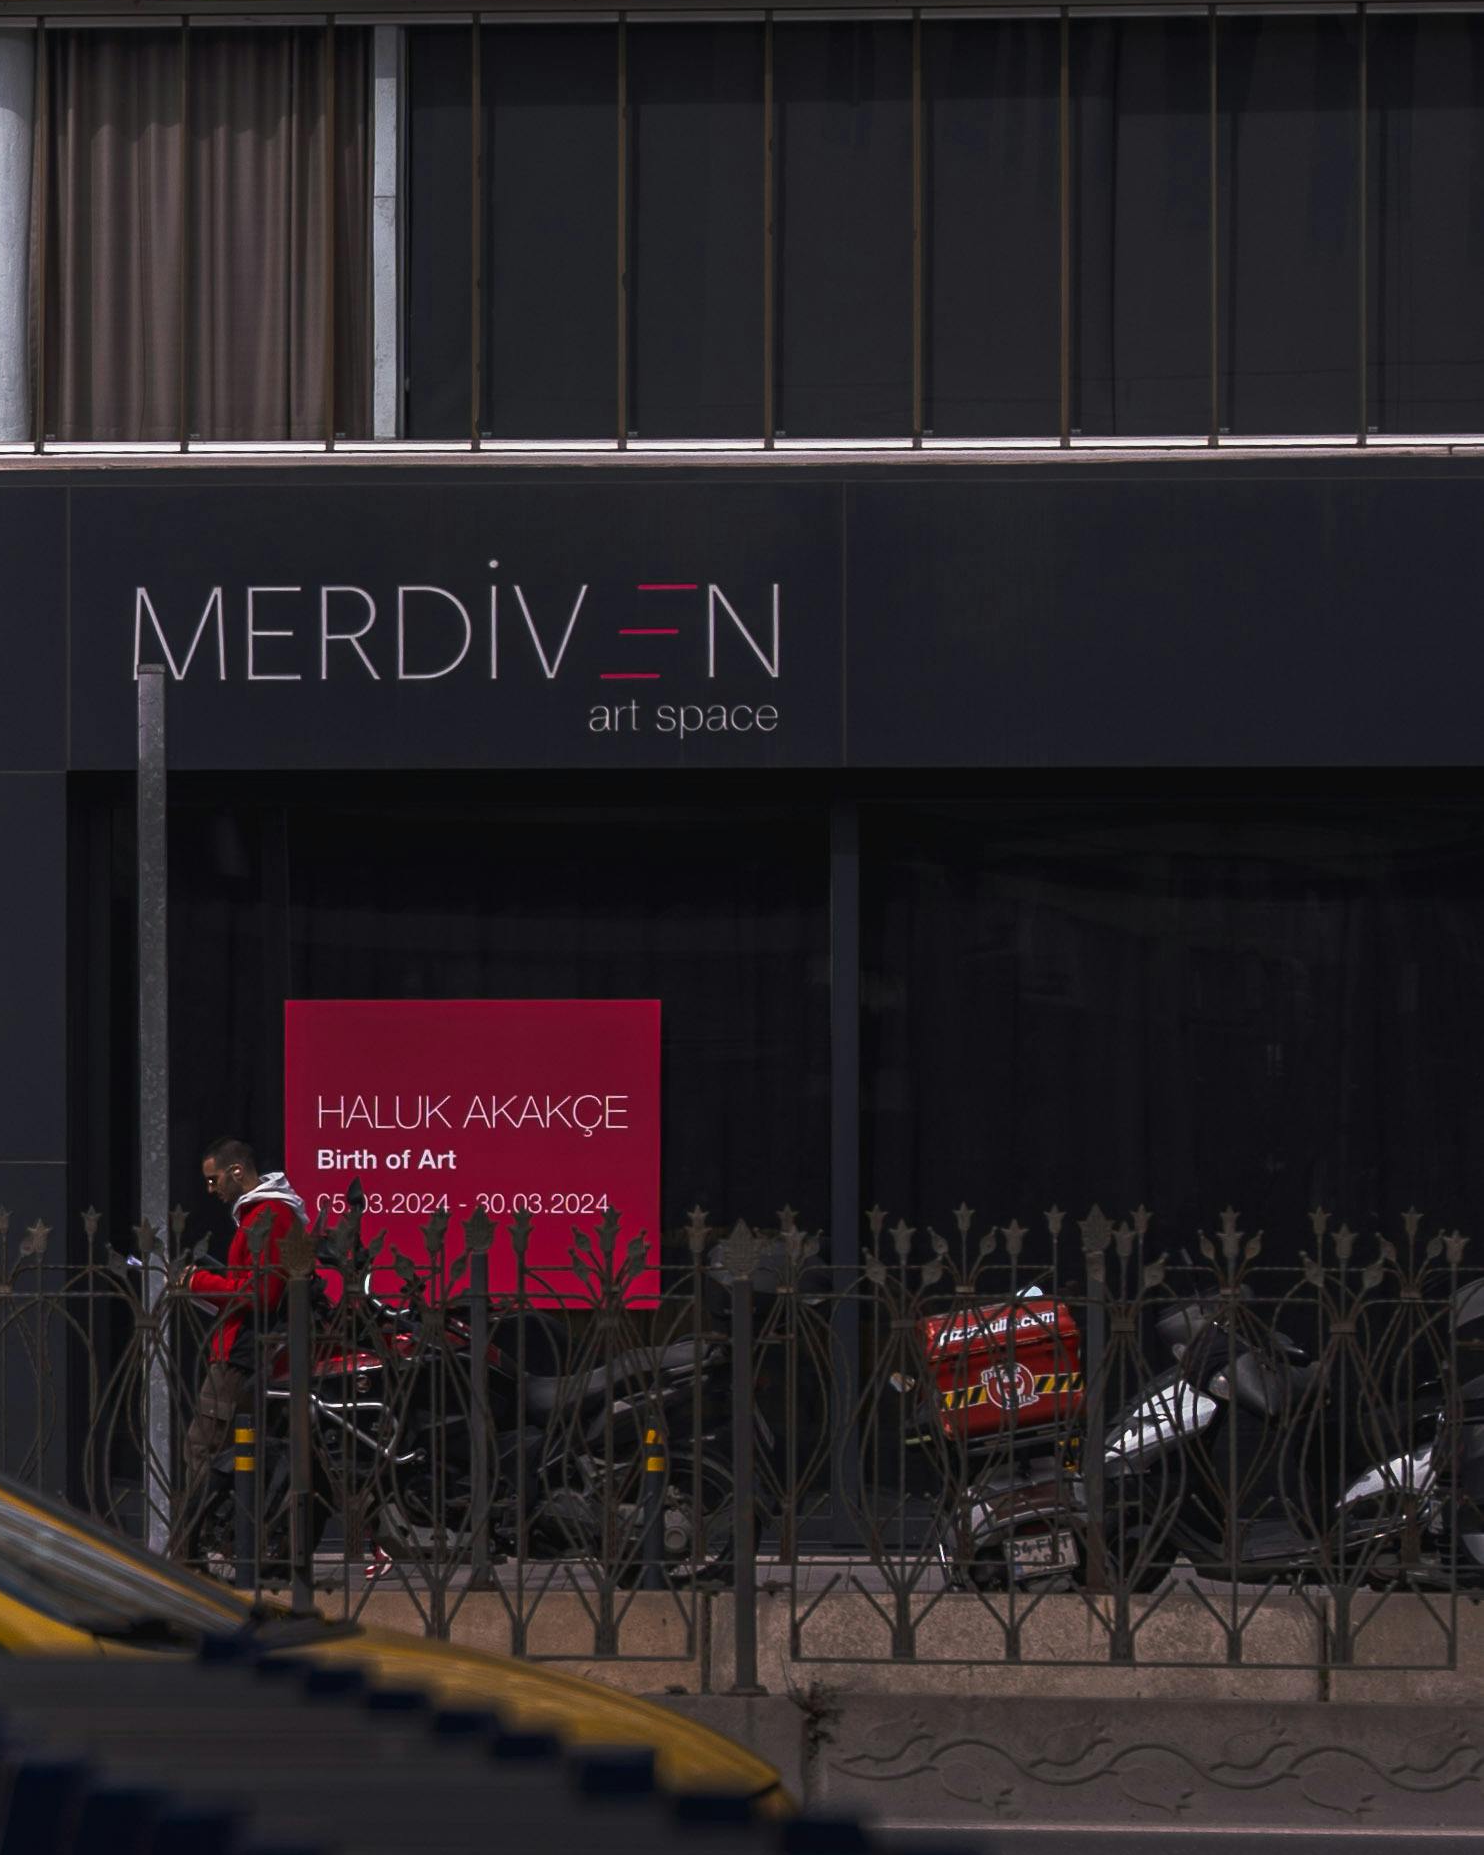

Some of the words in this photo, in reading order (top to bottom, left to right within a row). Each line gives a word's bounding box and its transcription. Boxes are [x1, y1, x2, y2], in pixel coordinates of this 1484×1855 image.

[589, 699, 640, 732] art
[656, 704, 779, 740] space
[318, 1095, 452, 1129] HALUK
[463, 1094, 629, 1137] AKAKÇE
[317, 1148, 378, 1170] Birth
[385, 1148, 412, 1170] of
[418, 1148, 457, 1170] Art
[475, 1193, 609, 1214] 30.03.2024
